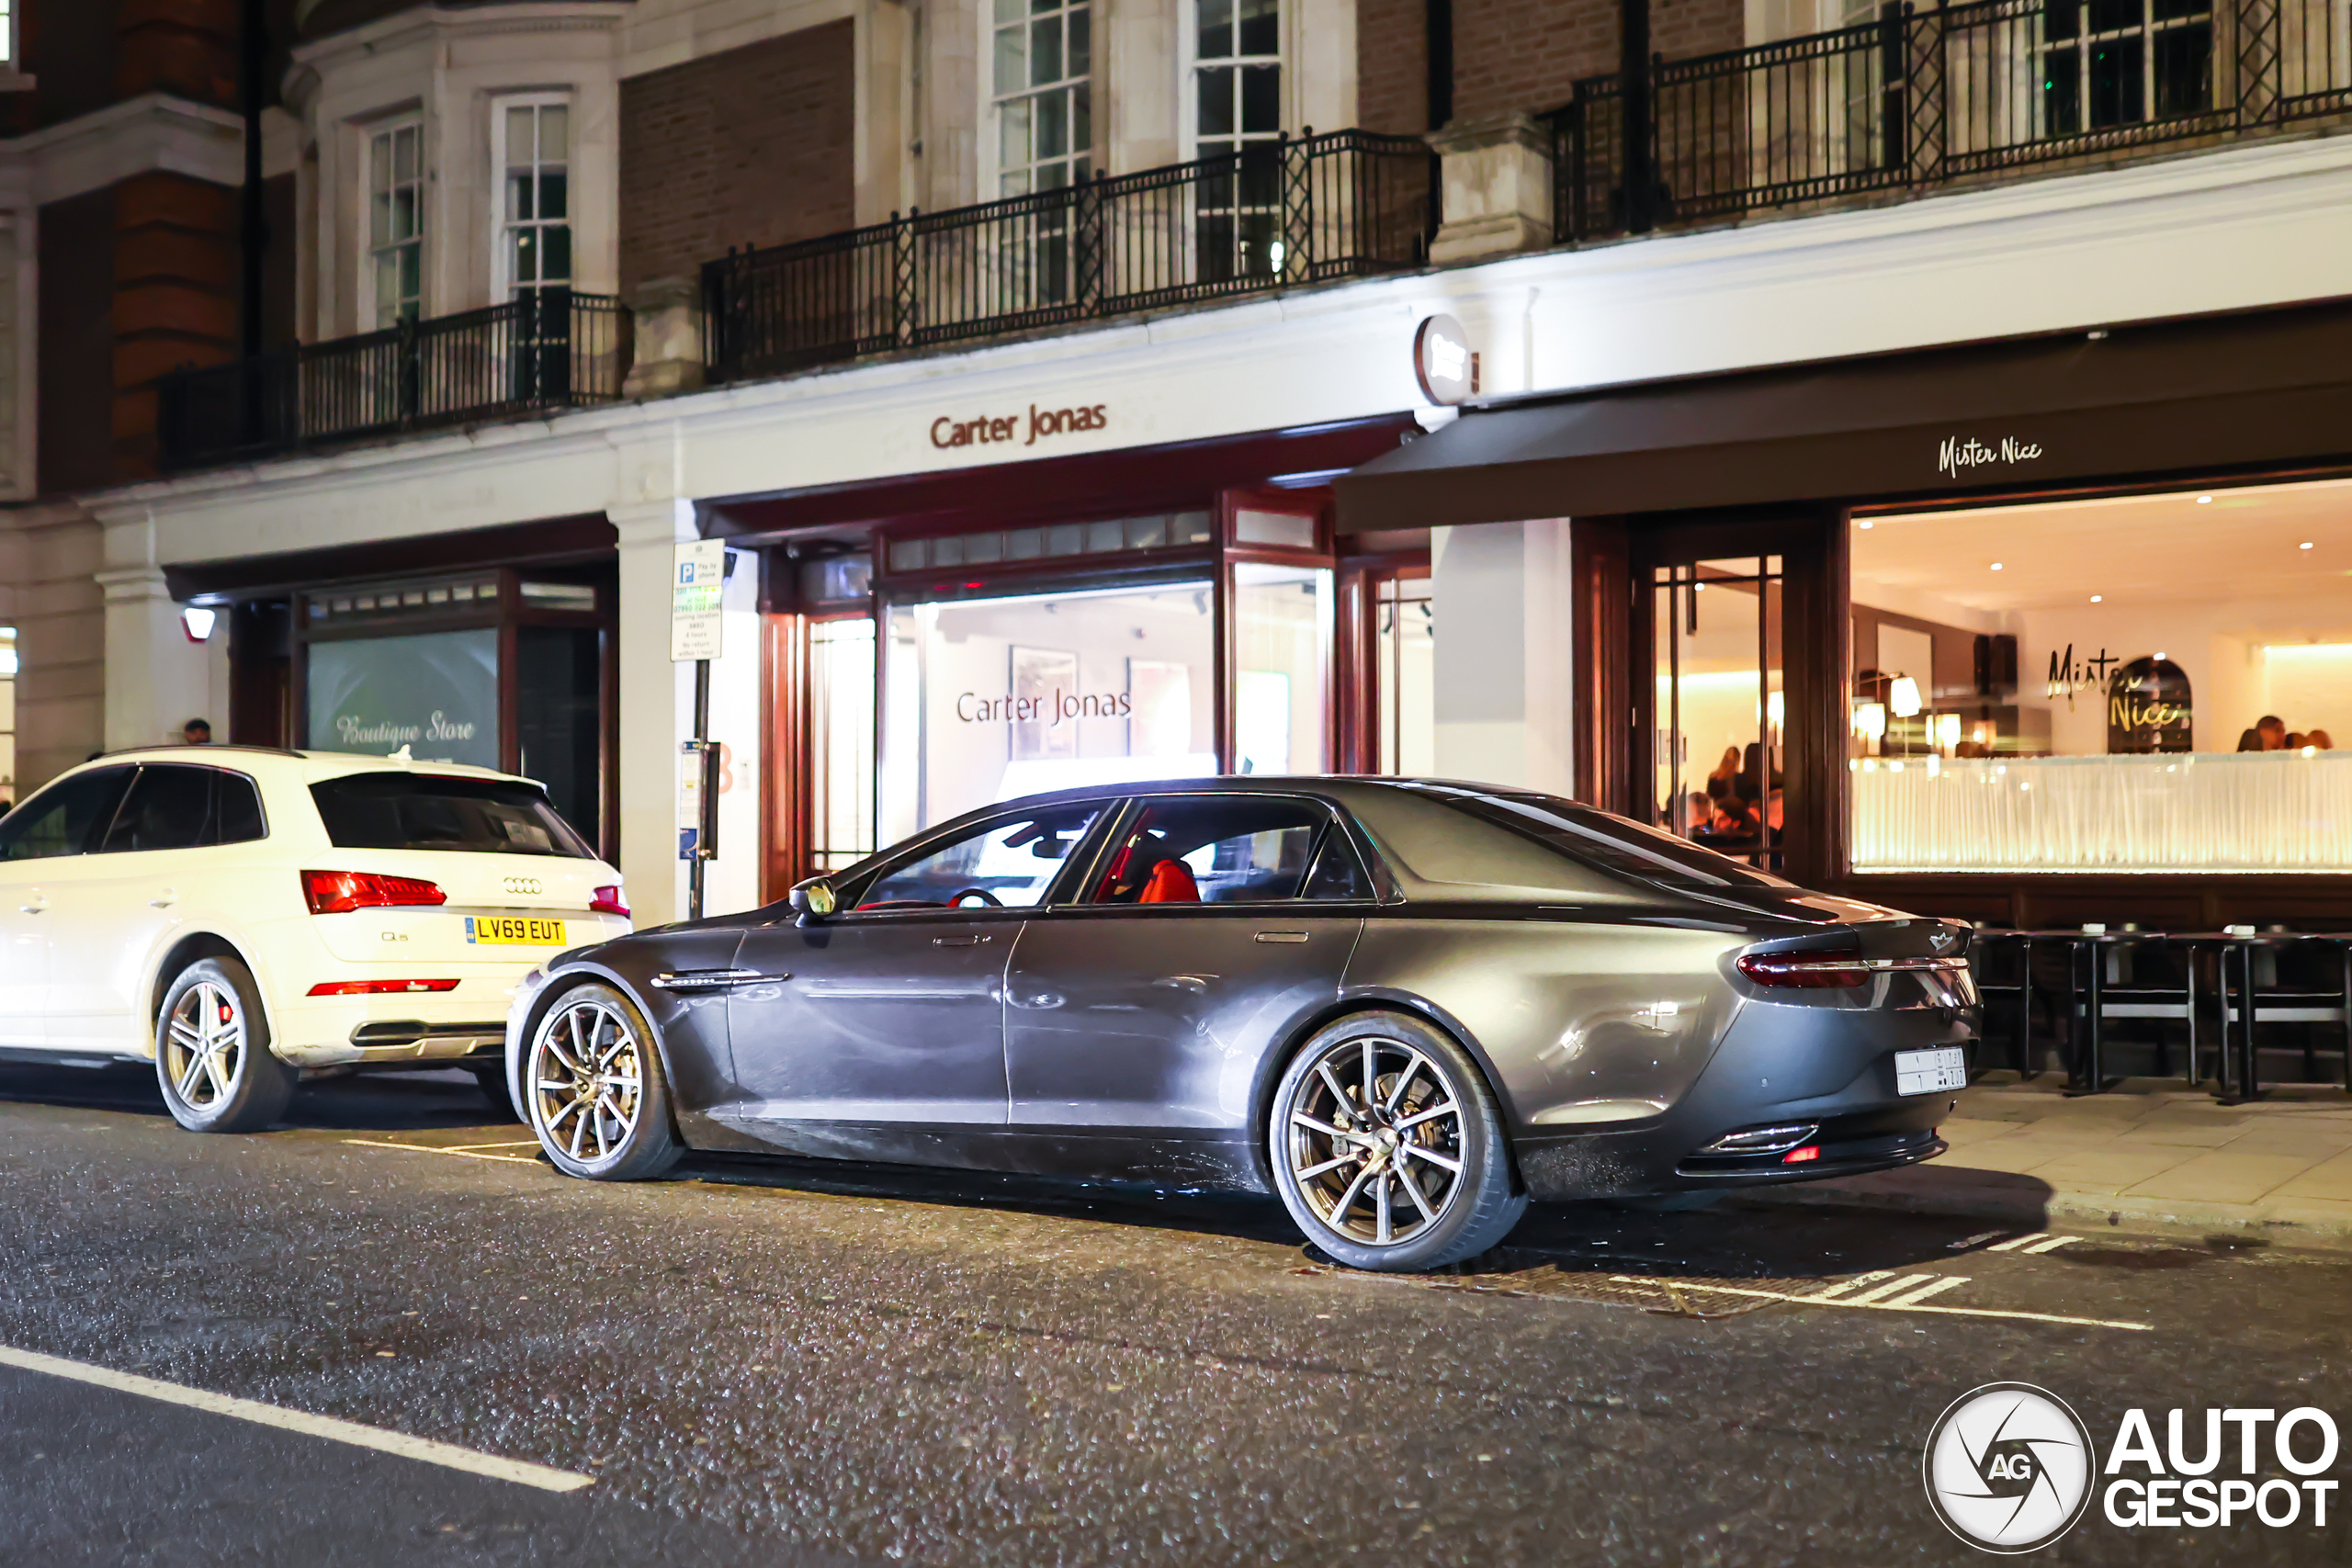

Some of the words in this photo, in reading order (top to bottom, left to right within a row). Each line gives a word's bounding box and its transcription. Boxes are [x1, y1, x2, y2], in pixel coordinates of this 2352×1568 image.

[930, 413, 1019, 449] Carter
[1024, 403, 1107, 446] Jonas
[1938, 434, 1997, 479] Mister
[2000, 434, 2043, 465] Nice
[698, 571, 716, 580] phone
[2047, 643, 2144, 713] Mister
[956, 691, 1044, 723] Carter
[1050, 687, 1132, 728] Jonas
[2109, 695, 2179, 733] Nice
[335, 714, 421, 750] Boutique
[425, 709, 475, 741] Store
[477, 919, 526, 939] LV69
[530, 920, 561, 940] EUT
